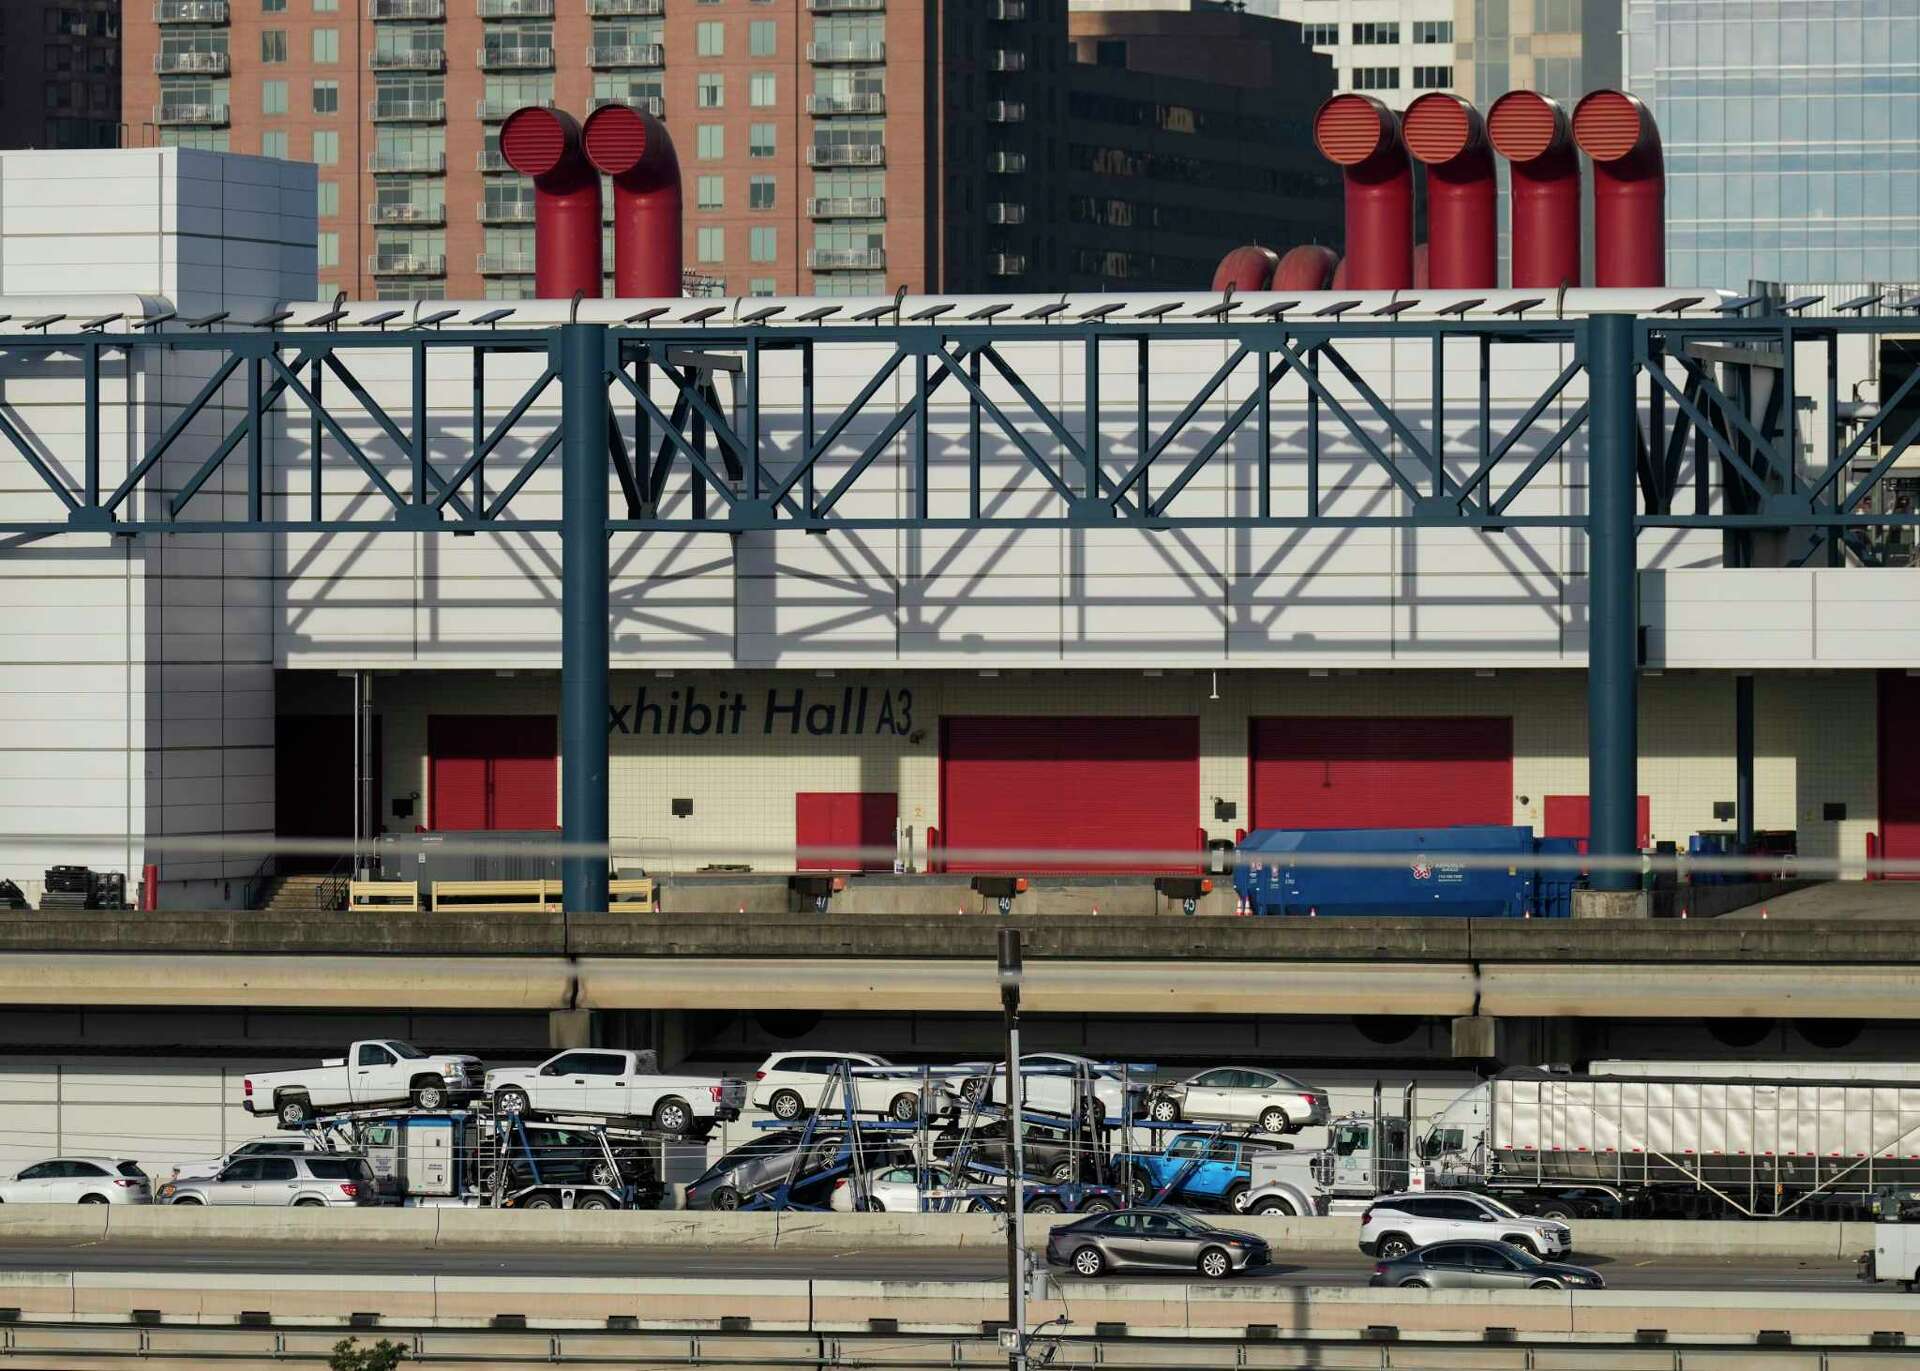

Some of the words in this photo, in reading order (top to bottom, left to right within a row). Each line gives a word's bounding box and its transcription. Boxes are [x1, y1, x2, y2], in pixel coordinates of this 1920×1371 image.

[608, 687, 747, 734] xhibit
[763, 687, 868, 735] Hall
[876, 688, 912, 735] A3
[999, 897, 1010, 910] 46
